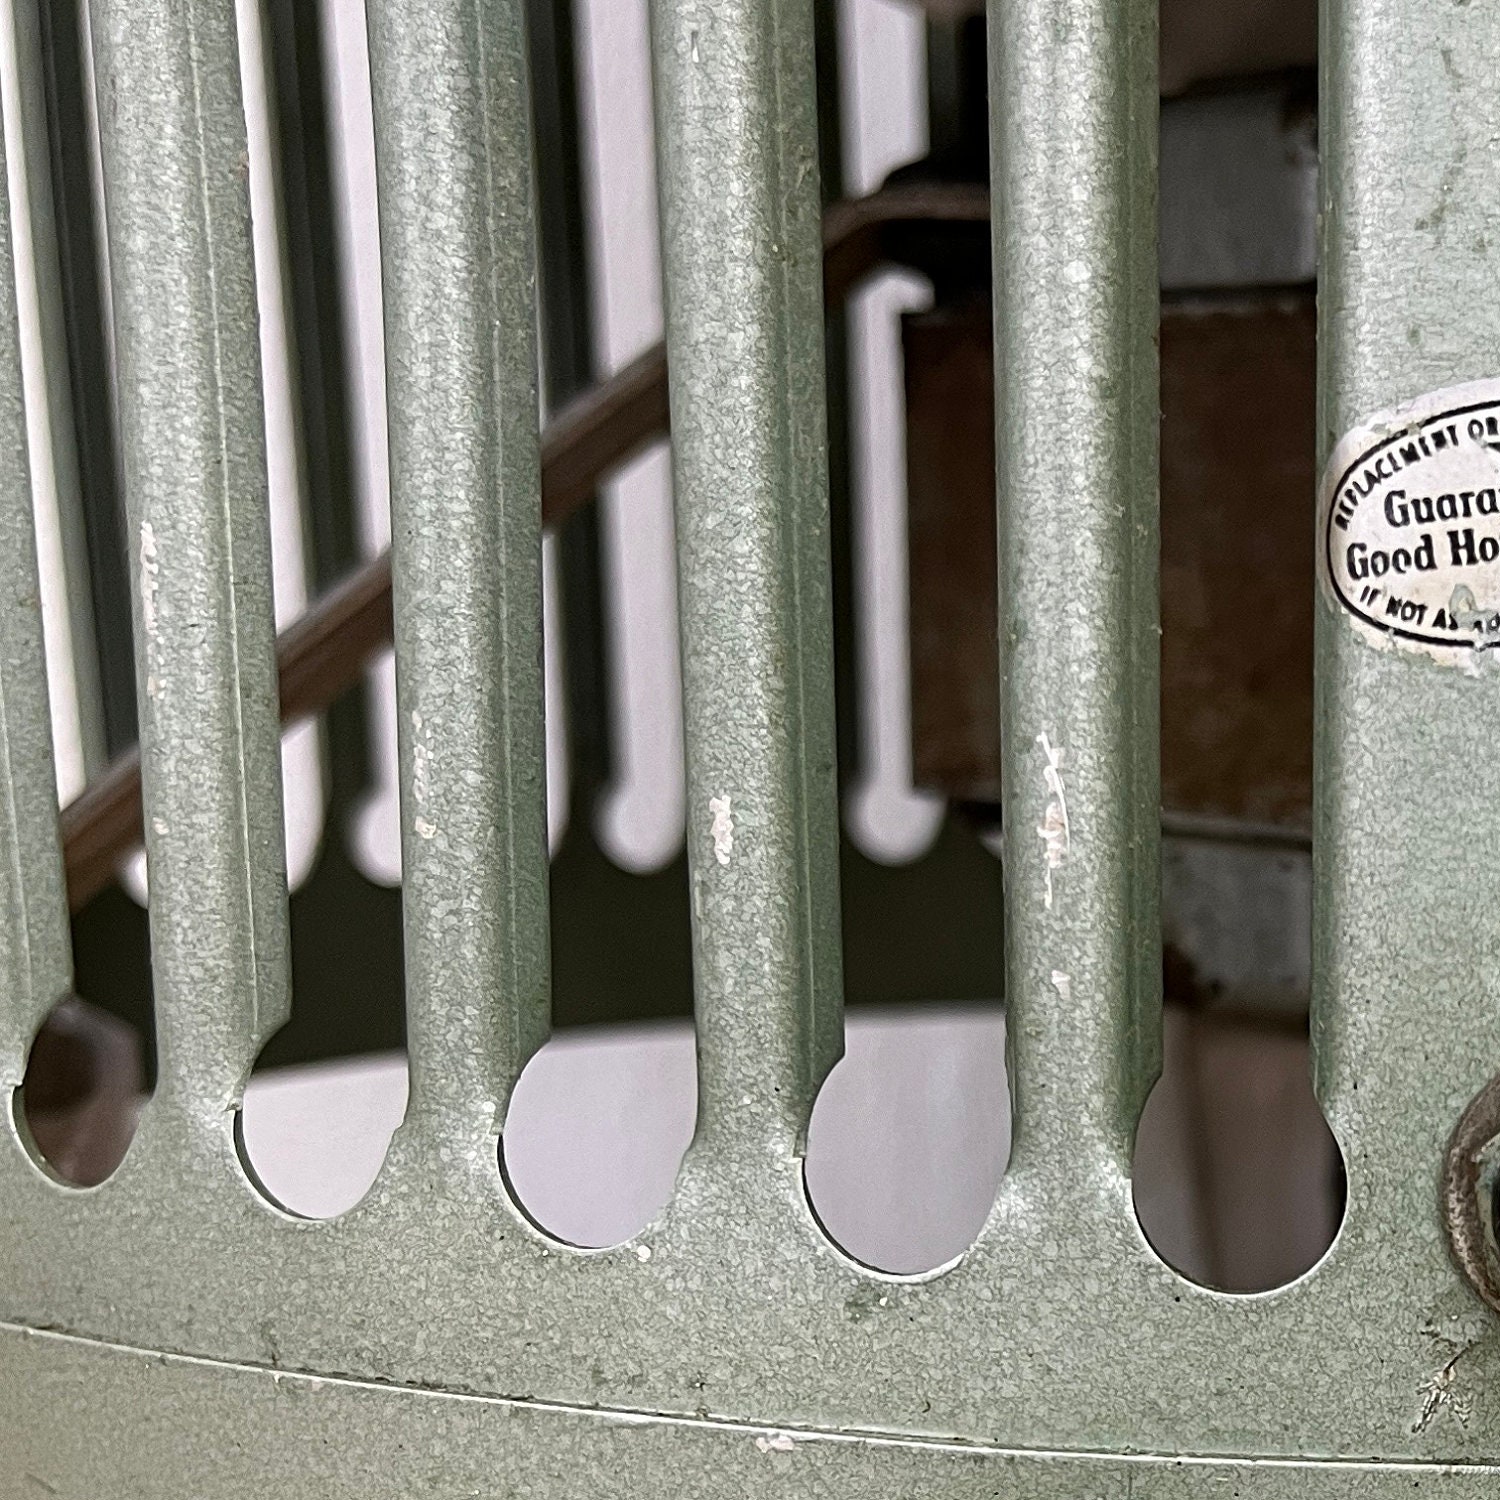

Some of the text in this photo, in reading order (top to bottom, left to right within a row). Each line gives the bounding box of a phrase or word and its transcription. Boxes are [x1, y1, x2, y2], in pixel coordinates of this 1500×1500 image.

[1335, 424, 1459, 530] REPLACEMENT
[1467, 416, 1499, 441] OR
[1346, 533, 1437, 582] Good
[1359, 585, 1382, 607] IF
[1385, 596, 1428, 626] NOT
